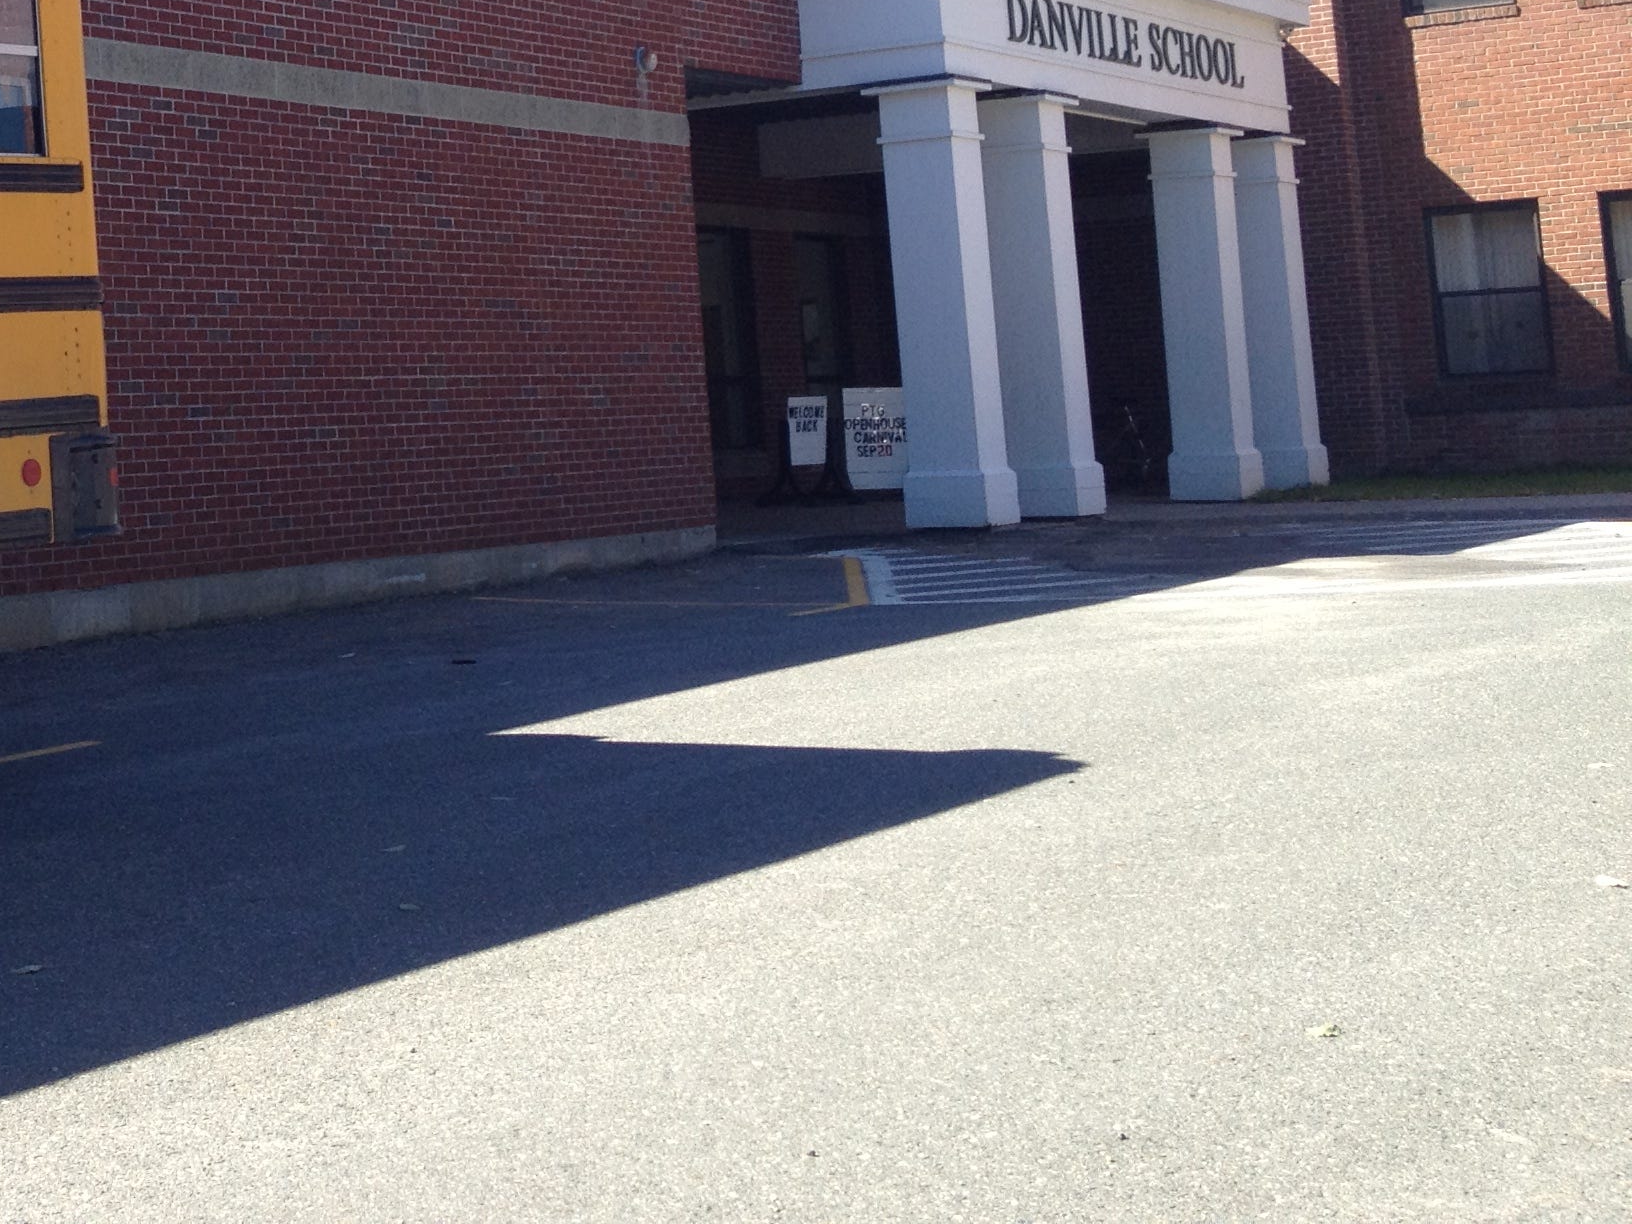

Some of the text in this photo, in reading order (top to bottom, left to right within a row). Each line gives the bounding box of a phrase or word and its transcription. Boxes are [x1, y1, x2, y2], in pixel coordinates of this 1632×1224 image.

[1148, 23, 1245, 88] SCHOOL
[788, 406, 824, 419] WELCOME
[796, 419, 818, 433] BACK
[853, 430, 907, 444] CARNIVAL
